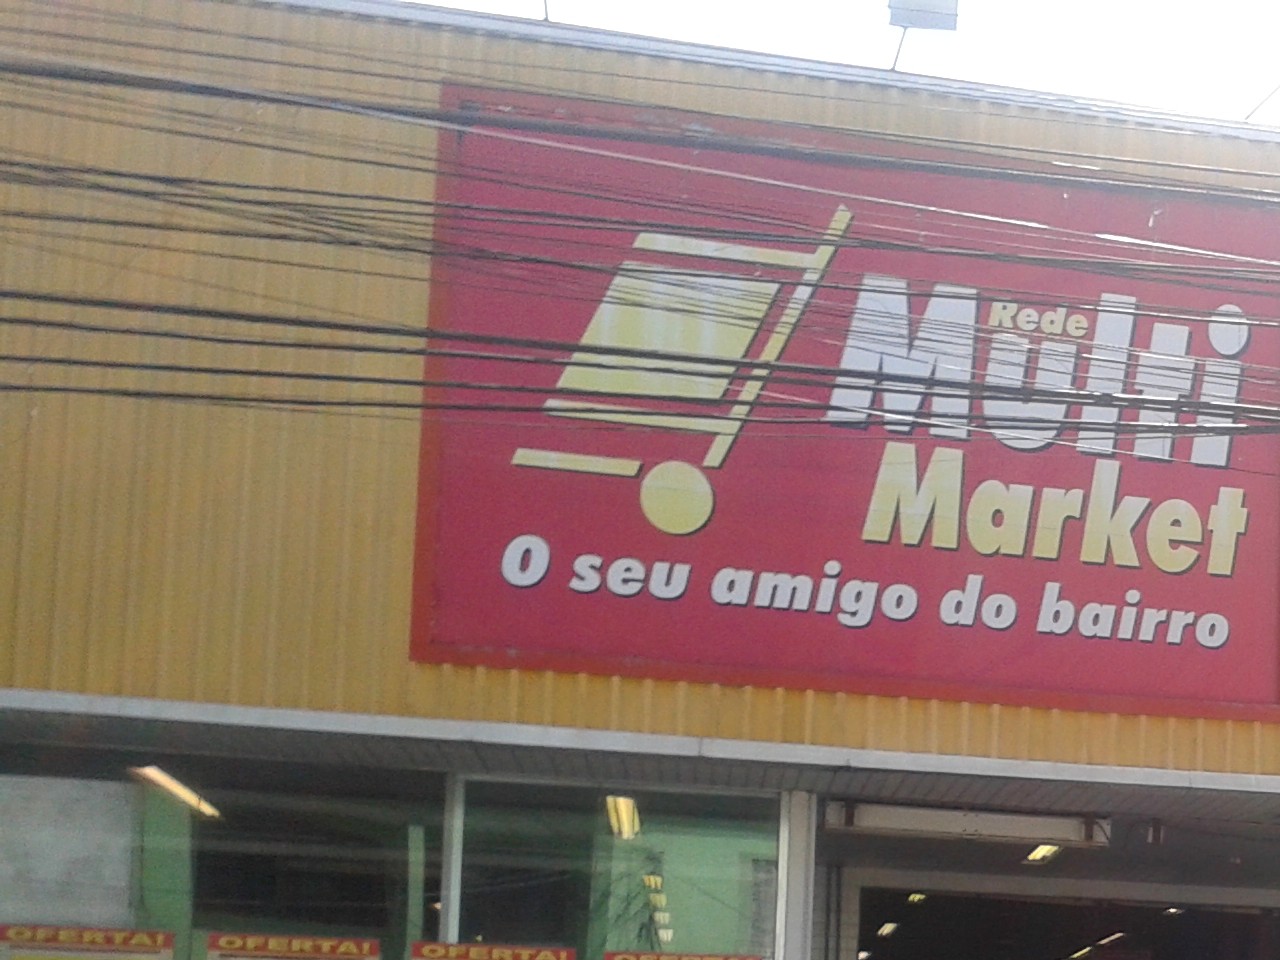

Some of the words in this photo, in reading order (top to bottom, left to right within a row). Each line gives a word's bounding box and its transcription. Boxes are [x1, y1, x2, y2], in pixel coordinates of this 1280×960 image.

[988, 302, 1088, 337] Rede
[826, 273, 1249, 467] Multi
[862, 441, 1248, 576] Market
[501, 535, 549, 587] O
[569, 552, 691, 599] seu
[711, 560, 918, 627] amigo
[939, 574, 1018, 628] do
[1036, 582, 1229, 649] bairro
[6, 926, 165, 946] OFERTA!
[218, 935, 371, 956] OFERTA!
